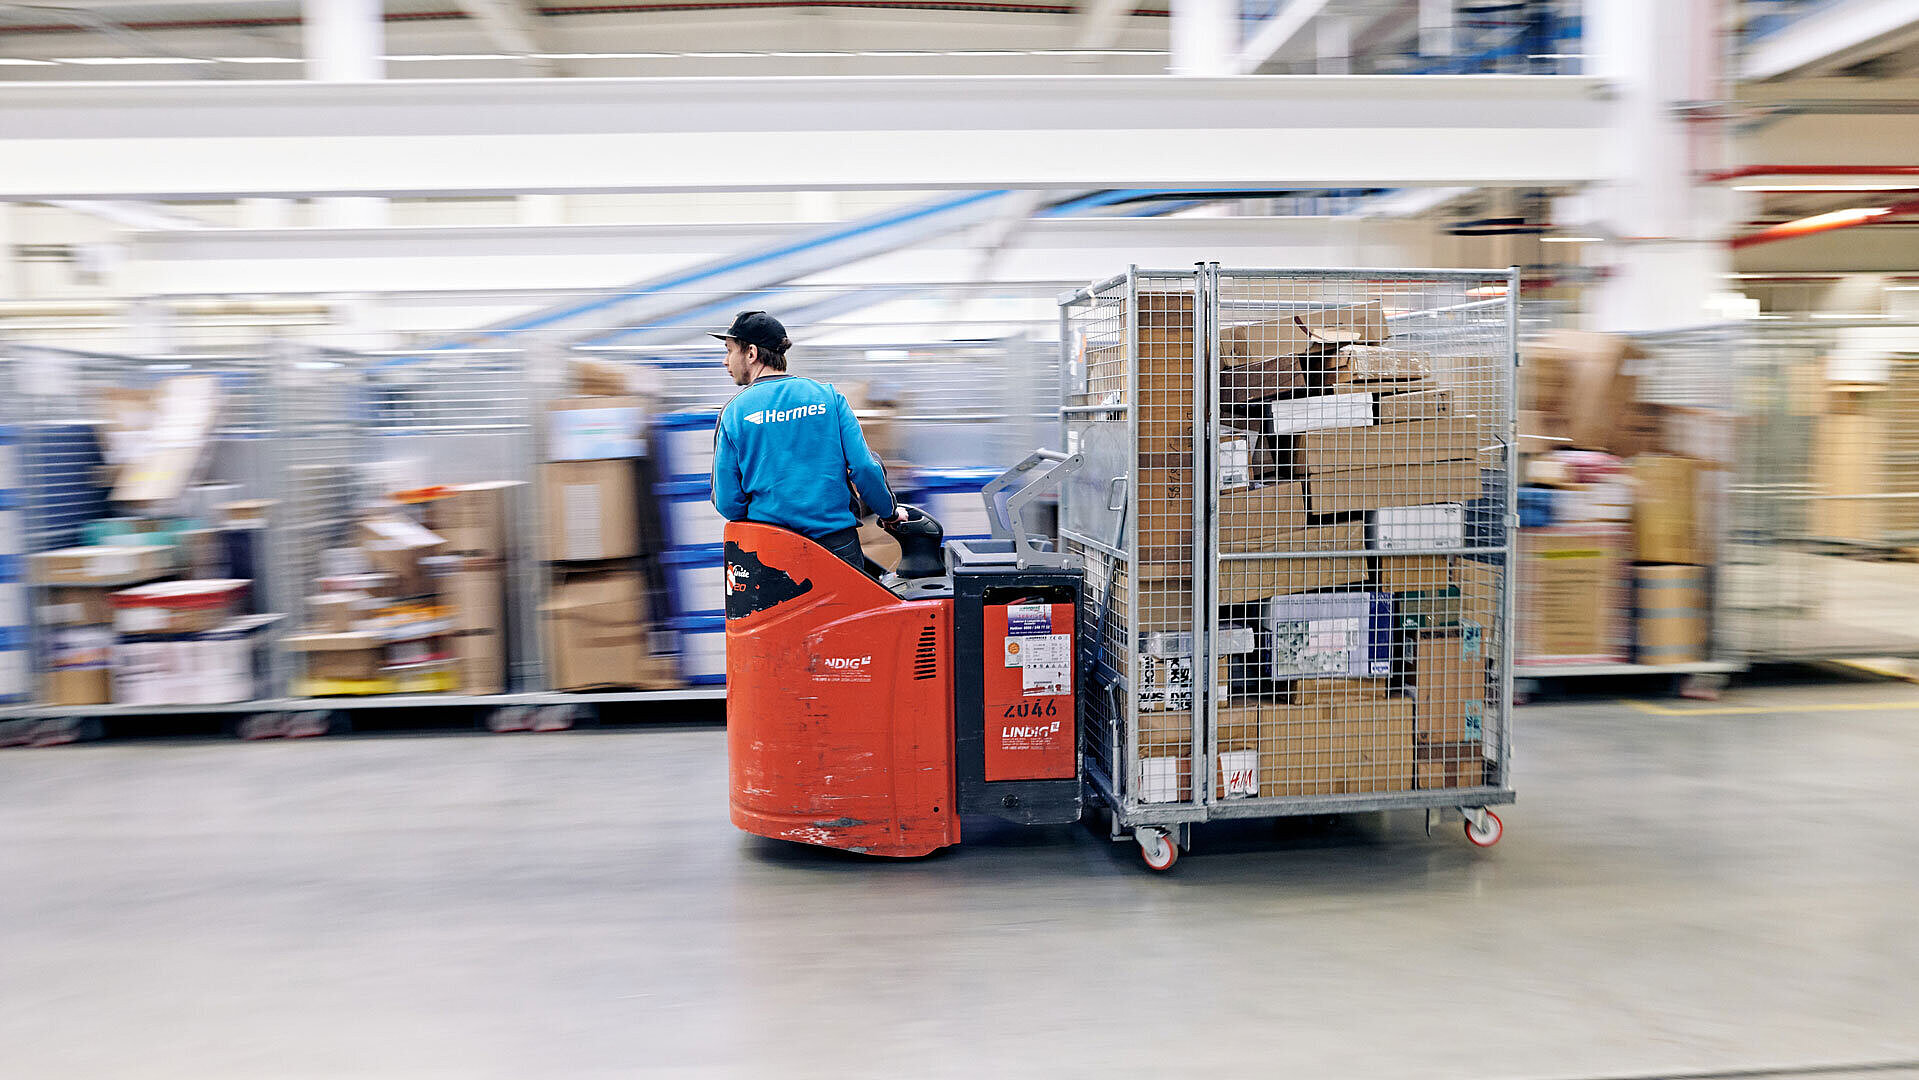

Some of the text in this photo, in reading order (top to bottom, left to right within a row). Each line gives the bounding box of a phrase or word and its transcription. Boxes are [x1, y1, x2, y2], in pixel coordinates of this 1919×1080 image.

[765, 403, 827, 423] Hermes
[824, 658, 860, 669] NDIG
[1002, 726, 1049, 738] LINDIG
